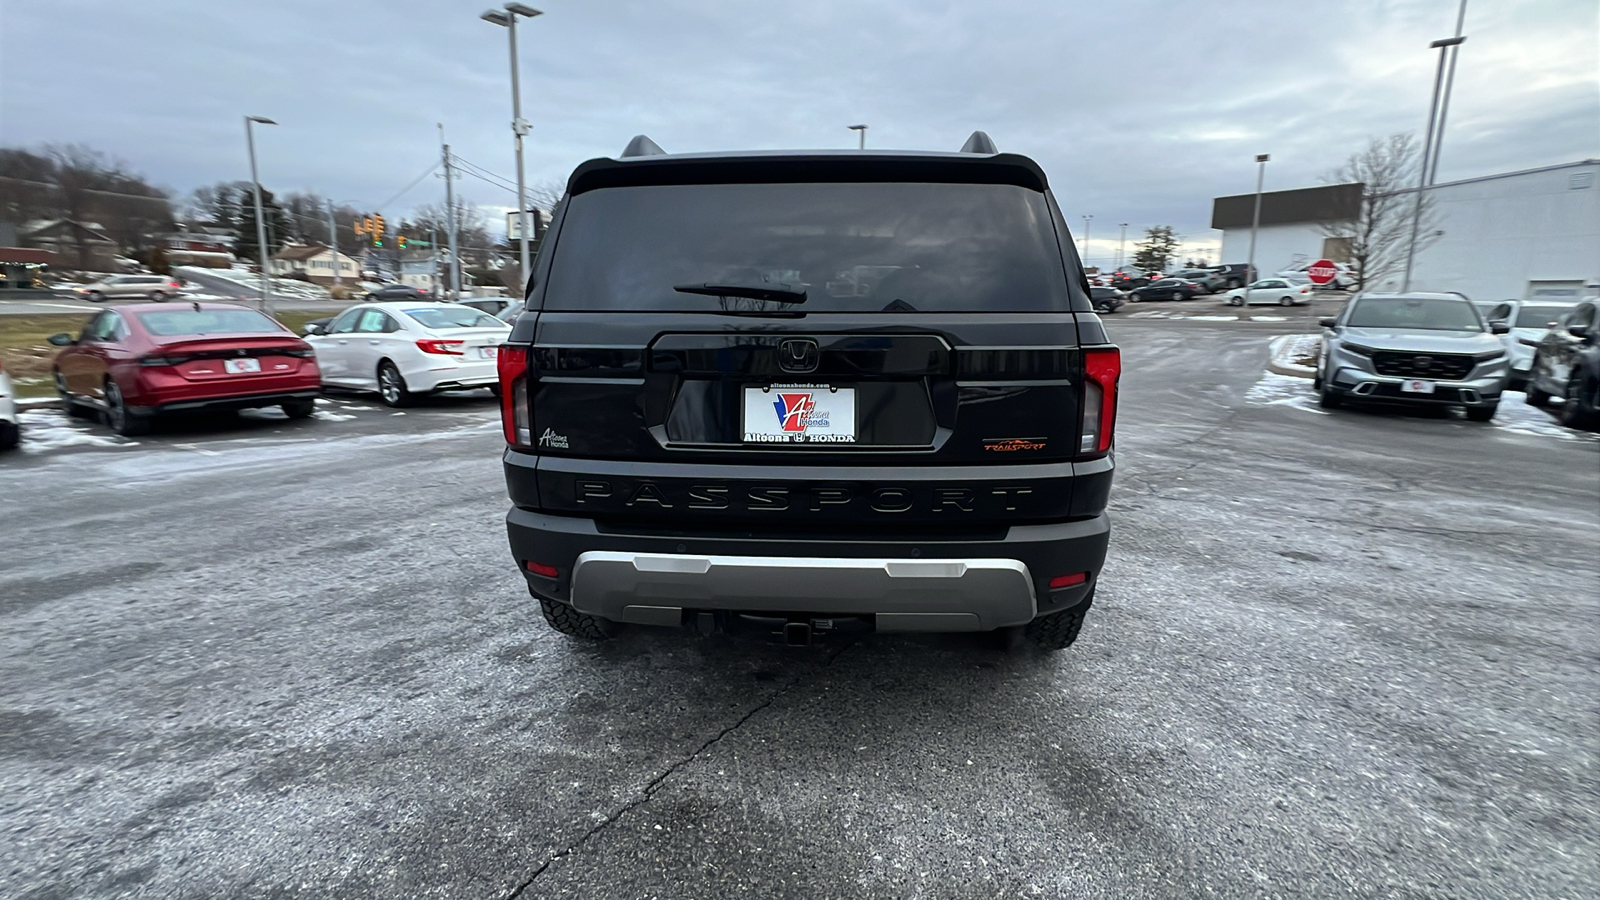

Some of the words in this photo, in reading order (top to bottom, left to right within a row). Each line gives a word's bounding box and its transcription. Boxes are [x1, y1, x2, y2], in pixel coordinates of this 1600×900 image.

[1308, 266, 1337, 277] STOP
[801, 418, 830, 427] Honda
[744, 433, 790, 442] Altoona
[809, 434, 855, 443] HONDA
[550, 440, 569, 448] Honda
[984, 443, 1046, 451] TRAILSPORT
[574, 480, 1033, 513] PASSPORT
